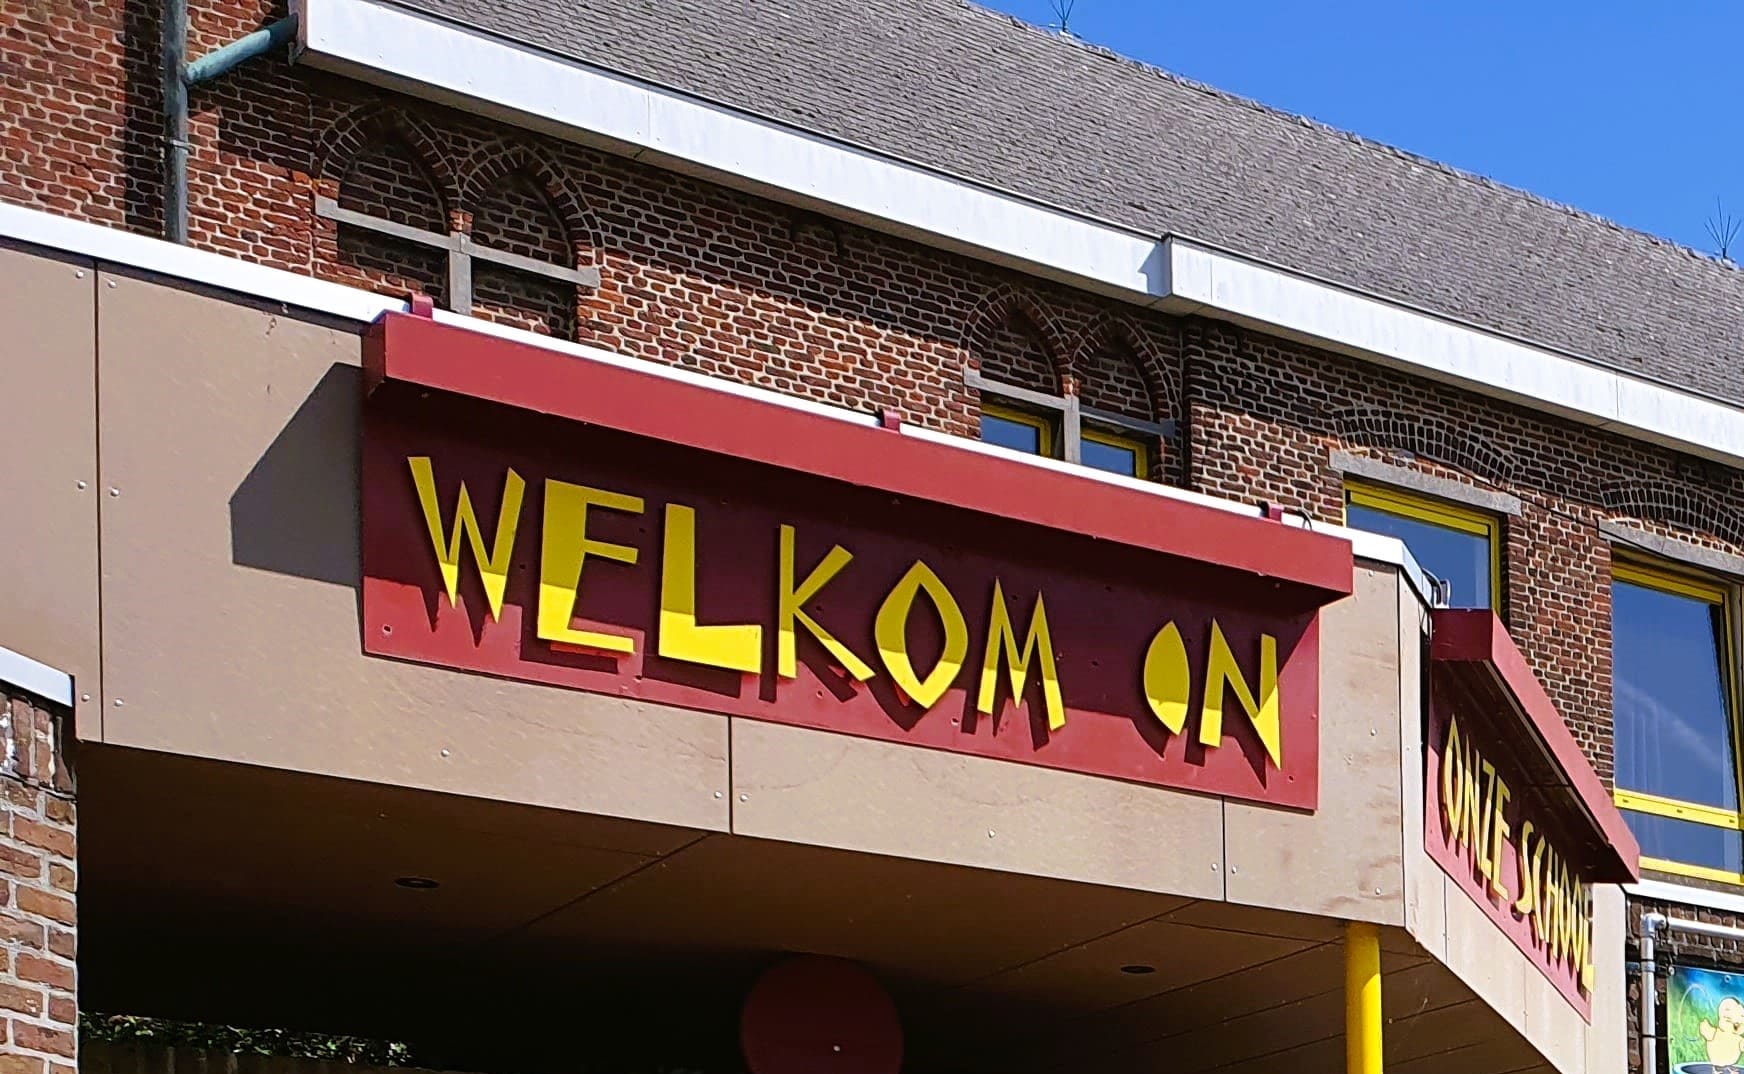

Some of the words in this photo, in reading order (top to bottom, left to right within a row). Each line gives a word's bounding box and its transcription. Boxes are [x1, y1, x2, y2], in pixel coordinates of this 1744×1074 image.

[408, 456, 1066, 731] WELKOM
[1444, 713, 1511, 901] ONZE
[1514, 819, 1595, 994] SCHOOL
